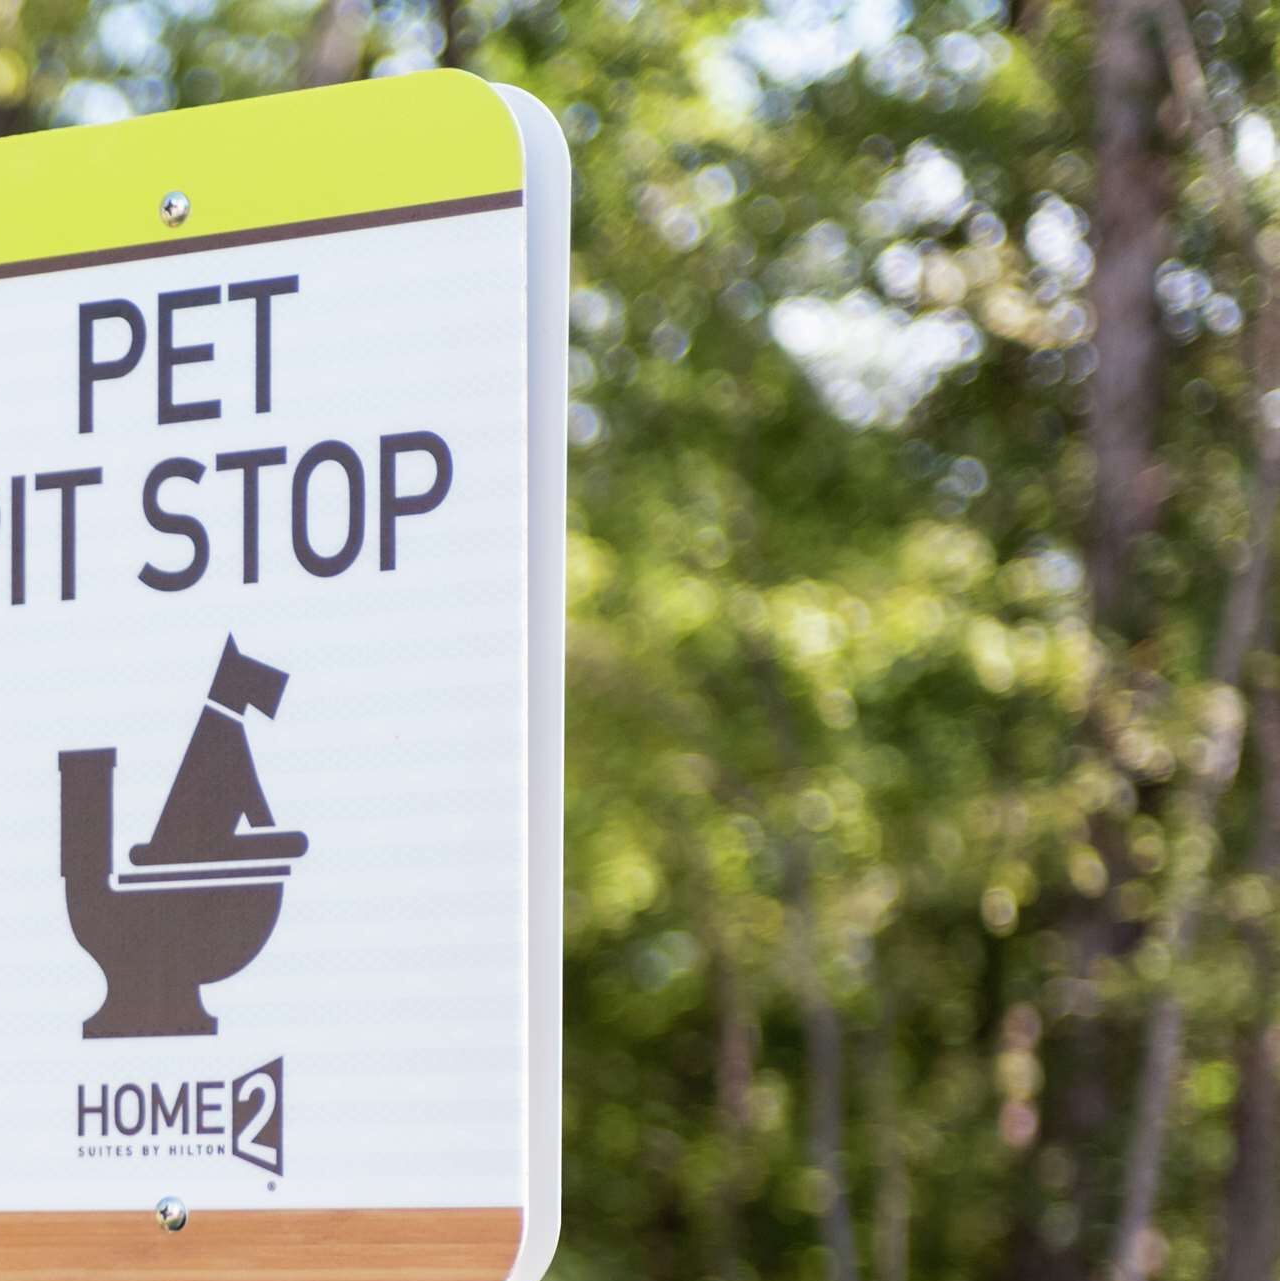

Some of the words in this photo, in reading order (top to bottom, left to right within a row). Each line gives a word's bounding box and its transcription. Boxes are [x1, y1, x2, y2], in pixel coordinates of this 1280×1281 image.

[78, 274, 299, 434] PET
[137, 430, 453, 592] STOP
[78, 1145, 133, 1158] SUITES
[142, 1145, 160, 1157] BY
[169, 1144, 226, 1156] HILTON
